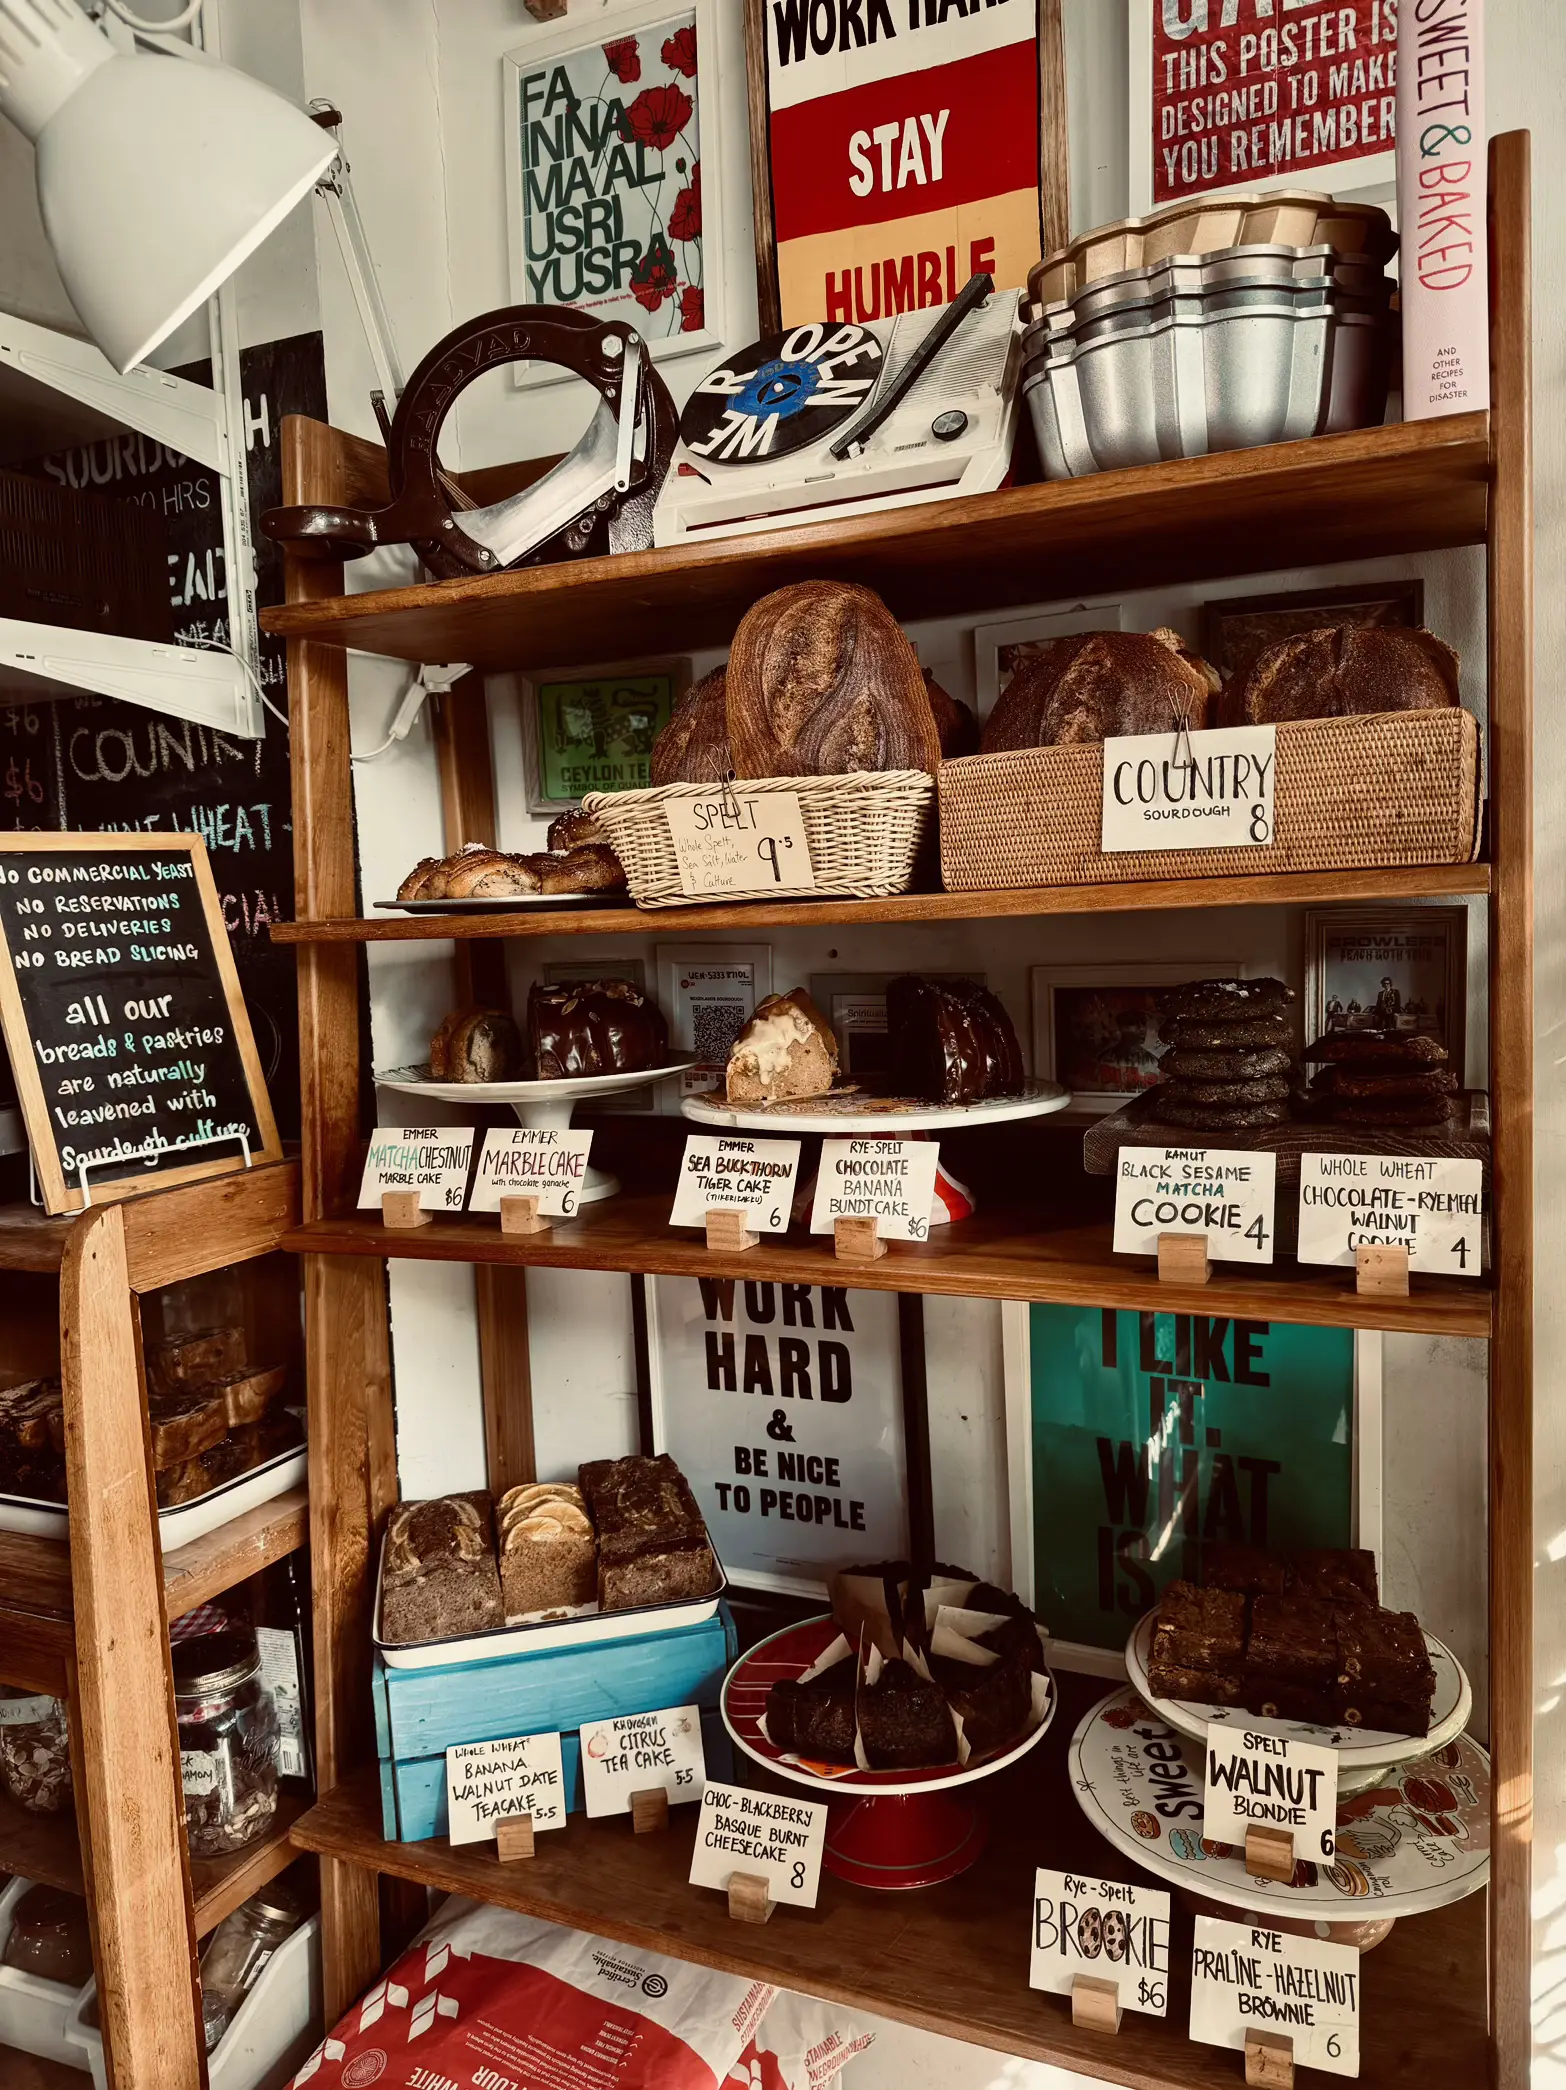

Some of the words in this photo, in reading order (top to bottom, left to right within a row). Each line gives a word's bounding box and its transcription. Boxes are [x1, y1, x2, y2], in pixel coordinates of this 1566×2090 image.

[1162, 40, 1228, 96] THIS
[1240, 9, 1356, 77] POSTER
[1372, 0, 1398, 45] IS
[522, 66, 577, 123] FA
[1162, 80, 1278, 140] DESIGNED
[1288, 72, 1318, 109] TO
[1329, 52, 1398, 94] MAKE
[523, 97, 634, 170] INNA
[1163, 135, 1218, 188] YOU
[1231, 95, 1396, 173] REMEMBER
[1419, 123, 1472, 160] &
[848, 109, 950, 197] STAY
[525, 194, 623, 262] USRI
[1418, 160, 1474, 291] BAKED
[525, 232, 677, 304] YUSRA
[780, 323, 881, 405] OPEN
[1433, 357, 1461, 369] OTHER
[1437, 346, 1457, 358] AND
[1431, 367, 1464, 381] RECIPES
[1439, 380, 1457, 390] FOR
[1429, 389, 1468, 404] DISASTER
[5, 756, 44, 806] $6
[561, 765, 623, 782] CEYLON
[629, 762, 651, 780] TE
[1114, 753, 1272, 805] COUNTRY
[561, 781, 600, 792] SYMBOL
[694, 800, 759, 830] SPELT
[1144, 805, 1230, 821] SOURDOUGH
[1250, 804, 1269, 842] 8
[679, 838, 702, 852] Whole
[28, 863, 150, 884] COMMERCIAL
[152, 862, 194, 880] YEAST
[703, 872, 736, 888] Culture
[16, 898, 44, 915] NO
[55, 892, 181, 913] RESERVATIONS
[24, 923, 51, 941] NO
[62, 918, 171, 938] DELIVERIES
[15, 950, 44, 969] NO
[54, 947, 121, 967] BREAD
[131, 944, 198, 962] SLICING
[65, 995, 110, 1026] all
[124, 993, 172, 1020] our
[36, 1034, 117, 1064] breads
[124, 1033, 135, 1052] &
[142, 1026, 224, 1055] pastries
[58, 1076, 94, 1096] are
[107, 1063, 206, 1089] naturally
[55, 1095, 155, 1129] leavened
[167, 1089, 216, 1111] with
[403, 1129, 438, 1140] EMMER
[512, 1130, 558, 1144] EMMER
[719, 1140, 755, 1152] EMMER
[850, 1141, 903, 1154] RYE-SPELT
[483, 1150, 545, 1176] MARBLE
[548, 1151, 585, 1177] CAKE
[688, 1155, 711, 1172] SEA
[715, 1158, 792, 1178] BUCKTHORN
[836, 1159, 909, 1176] CHOCOLATE
[1165, 1150, 1207, 1161] KAMUT
[379, 1172, 414, 1184] MARBLE
[417, 1173, 442, 1184] CAKE
[1122, 1162, 1172, 1178] BLACK
[1182, 1165, 1251, 1181] SESAME
[1320, 1158, 1367, 1176] WHOLE
[1380, 1161, 1438, 1180] WHEAT
[492, 1178, 506, 1186] with
[509, 1179, 539, 1188] chocolate
[542, 1180, 570, 1188] ganache
[697, 1176, 732, 1192] TIGER
[737, 1179, 771, 1194] CAKE
[844, 1179, 903, 1197] BANANA
[1156, 1182, 1225, 1197] MATCHA
[446, 1187, 462, 1206] $6
[562, 1190, 575, 1213] 6
[830, 1199, 873, 1214] BUNDT
[874, 1200, 909, 1216] CAKE
[1303, 1185, 1481, 1214] CHOCOLATE-RYEMEAL
[770, 1208, 781, 1227] 6
[1131, 1198, 1241, 1228] COOKIE
[1351, 1211, 1420, 1233] WALNUT
[908, 1217, 927, 1238] $6
[1244, 1214, 1269, 1250] 4
[1451, 1237, 1470, 1268] 4
[1139, 1311, 1270, 1387] LIKE
[705, 1331, 852, 1403] HARD
[766, 1409, 796, 1442] &
[734, 1446, 768, 1477] BE
[777, 1451, 840, 1487] NICE
[715, 1482, 750, 1513] TO
[760, 1488, 866, 1531] PEOPLE
[1097, 1437, 1281, 1550] WHAT
[455, 1746, 485, 1758] WHOLE
[491, 1740, 527, 1753] WHEAT
[620, 1727, 667, 1750] CITRUS
[1243, 1732, 1289, 1758] SPELT
[465, 1757, 527, 1779] BANANA
[600, 1753, 629, 1774] TEA
[634, 1748, 675, 1768] CAKE
[452, 1777, 513, 1801] WALNUT
[519, 1769, 558, 1788] DATE
[675, 1768, 693, 1785] 5.5
[1209, 1749, 1325, 1811] WALNUT
[471, 1793, 536, 1822] TEACAKE
[534, 1806, 556, 1819] 5.5
[704, 1790, 813, 1827] CHOC-BLACKBERRY
[1233, 1795, 1307, 1826] BLONDIE
[715, 1814, 761, 1838] BASQUE
[769, 1828, 809, 1847] BURNT
[1320, 1829, 1334, 1857] 6
[705, 1832, 787, 1862] CHEESECAKE
[791, 1861, 805, 1888] 8
[1064, 1875, 1135, 1905] Rye-Spelt
[1036, 1897, 1170, 1974] BROOKIE
[1251, 1929, 1282, 1953] RYE
[598, 1967, 637, 1989] Certified
[1193, 1949, 1357, 2012] PRALINE-HAZELNUT
[1138, 1976, 1165, 2008] $6
[1238, 1993, 1315, 2026] BROWNIE
[1327, 2033, 1341, 2058] 6
